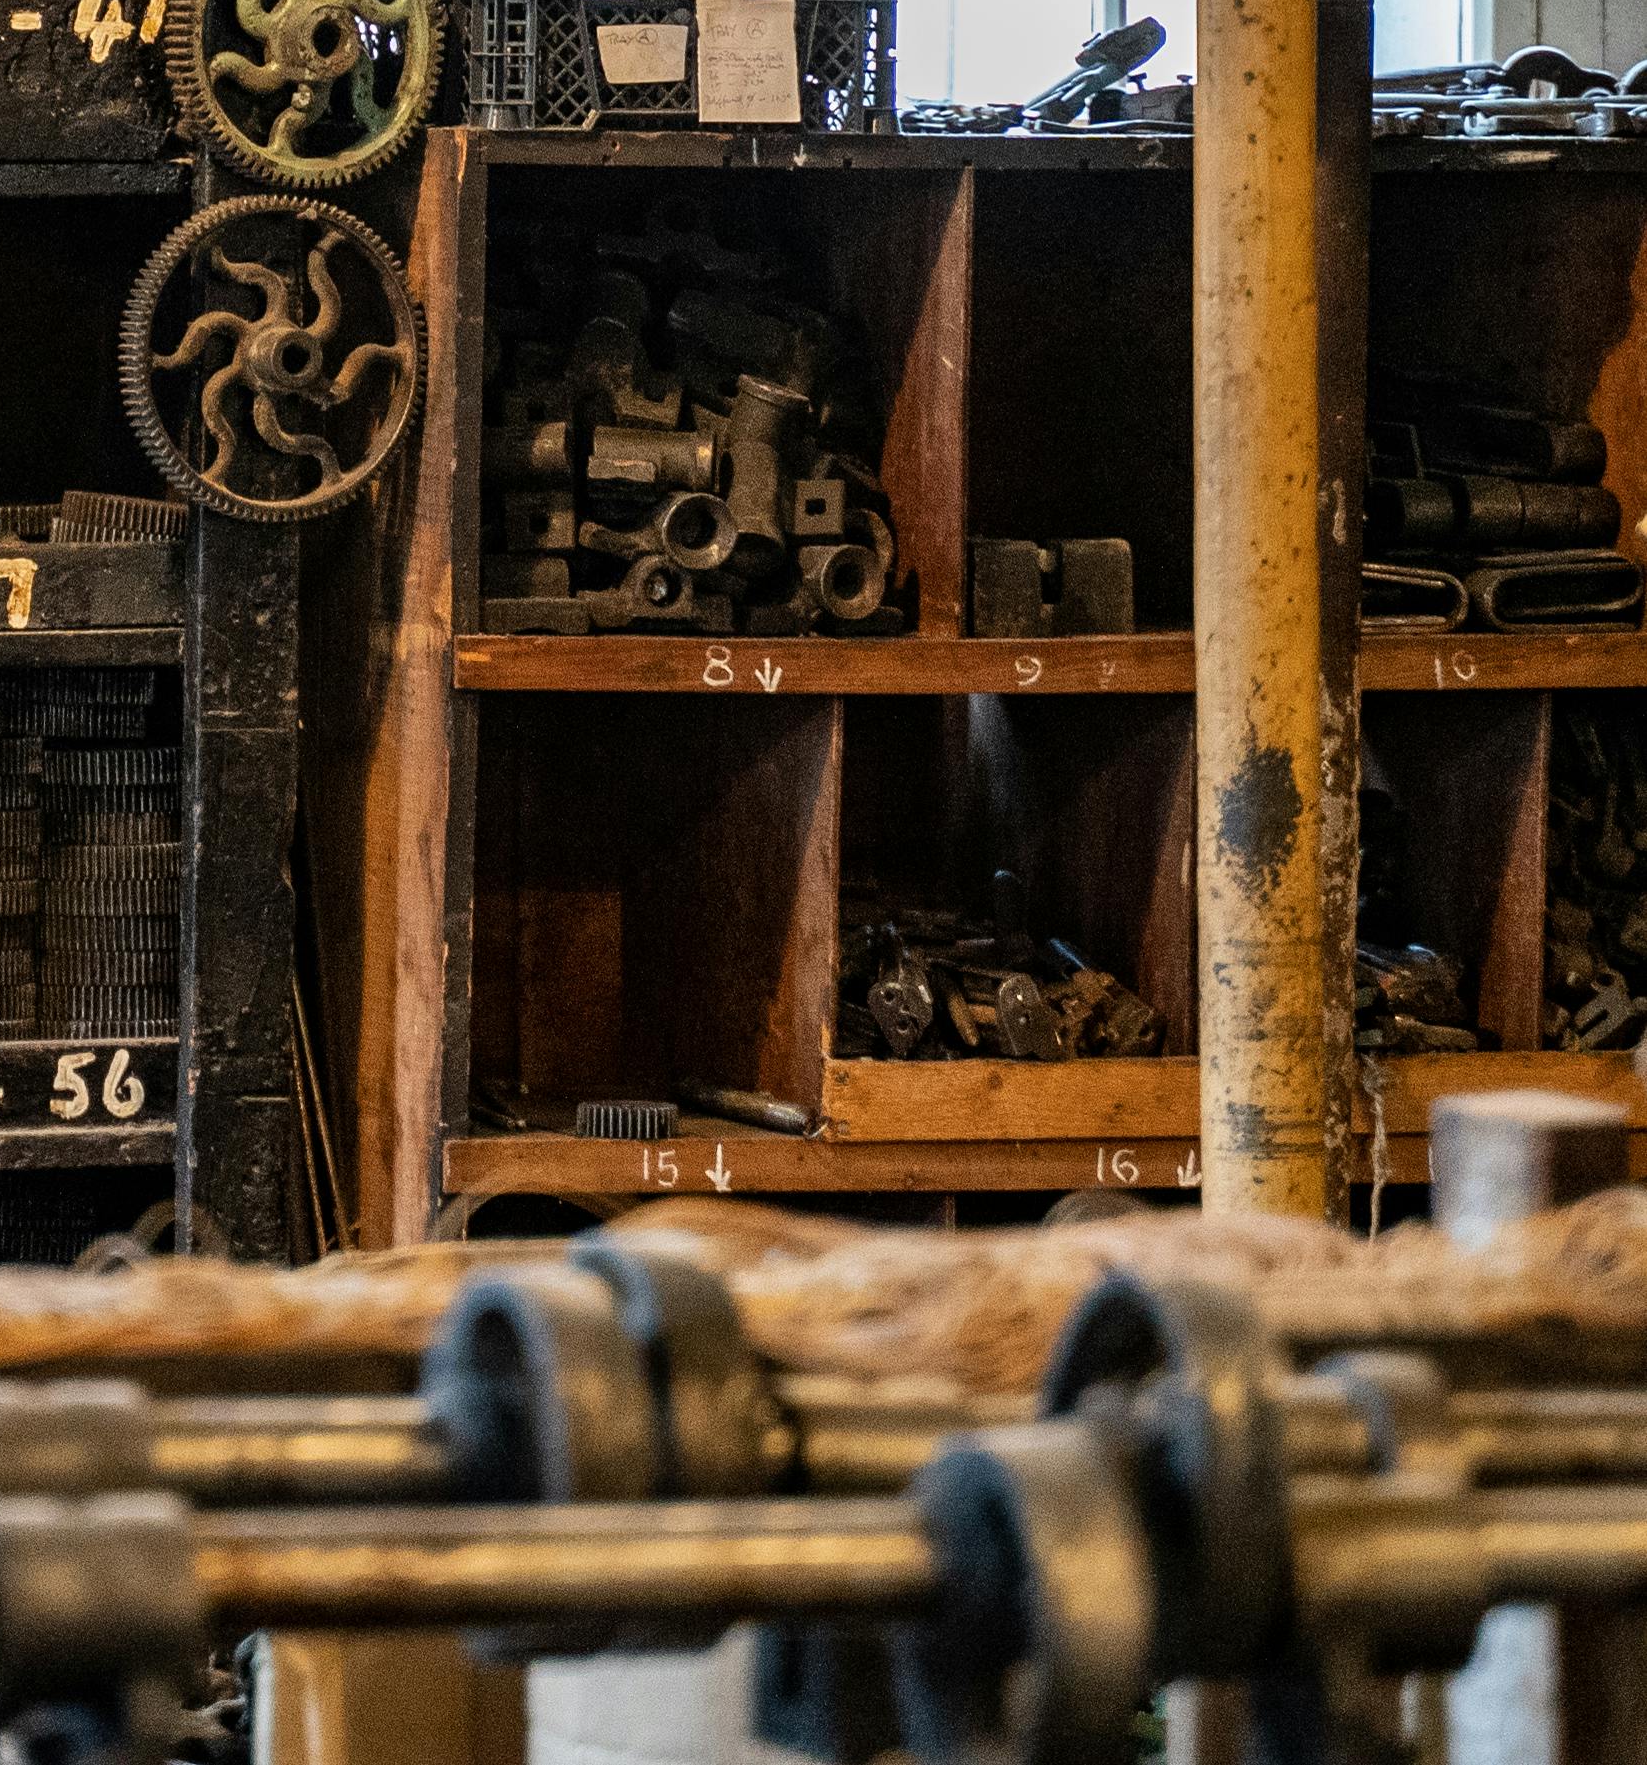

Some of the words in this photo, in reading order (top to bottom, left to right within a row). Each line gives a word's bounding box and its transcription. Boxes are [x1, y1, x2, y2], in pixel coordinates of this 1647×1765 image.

[602, 33, 634, 46] TRAY
[707, 24, 737, 42] TRAY
[702, 645, 733, 686] 8
[1014, 655, 1042, 686] 9
[1434, 651, 1476, 689] 10
[50, 1049, 144, 1119] 56
[643, 1147, 678, 1188] 15
[1096, 1146, 1140, 1184] 16
